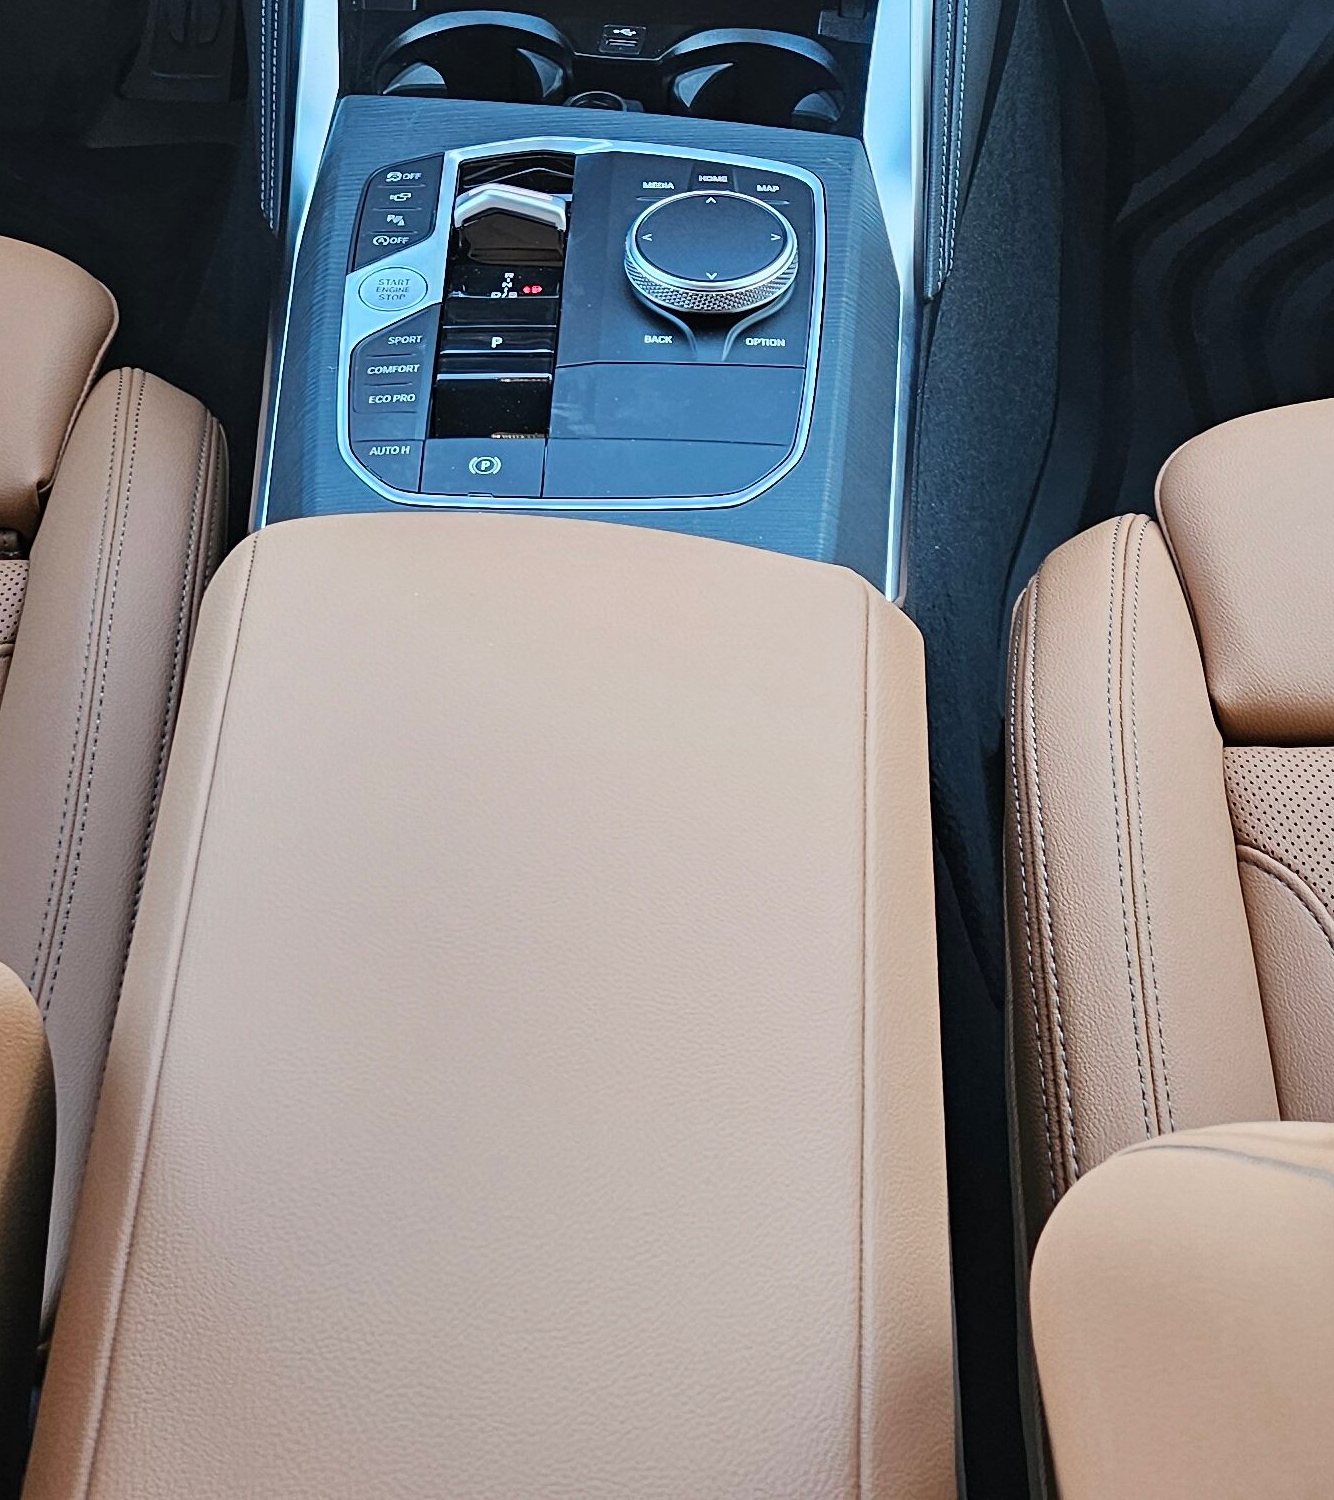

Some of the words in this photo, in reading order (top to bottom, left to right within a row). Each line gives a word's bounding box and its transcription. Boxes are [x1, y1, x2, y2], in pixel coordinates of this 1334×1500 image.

[403, 172, 422, 180] OFF
[642, 182, 675, 190] MEDIA
[756, 185, 780, 193] MAP
[390, 236, 409, 245] OFF
[379, 293, 406, 301] STOP
[388, 335, 423, 345] SPORT
[491, 337, 502, 348] P
[644, 335, 673, 344] BACK
[745, 338, 786, 347] OPTION
[367, 364, 420, 375] COMFORT
[368, 395, 391, 404] ECO
[392, 394, 416, 402] PRO
[369, 446, 399, 456] AUTO
[401, 446, 410, 454] H
